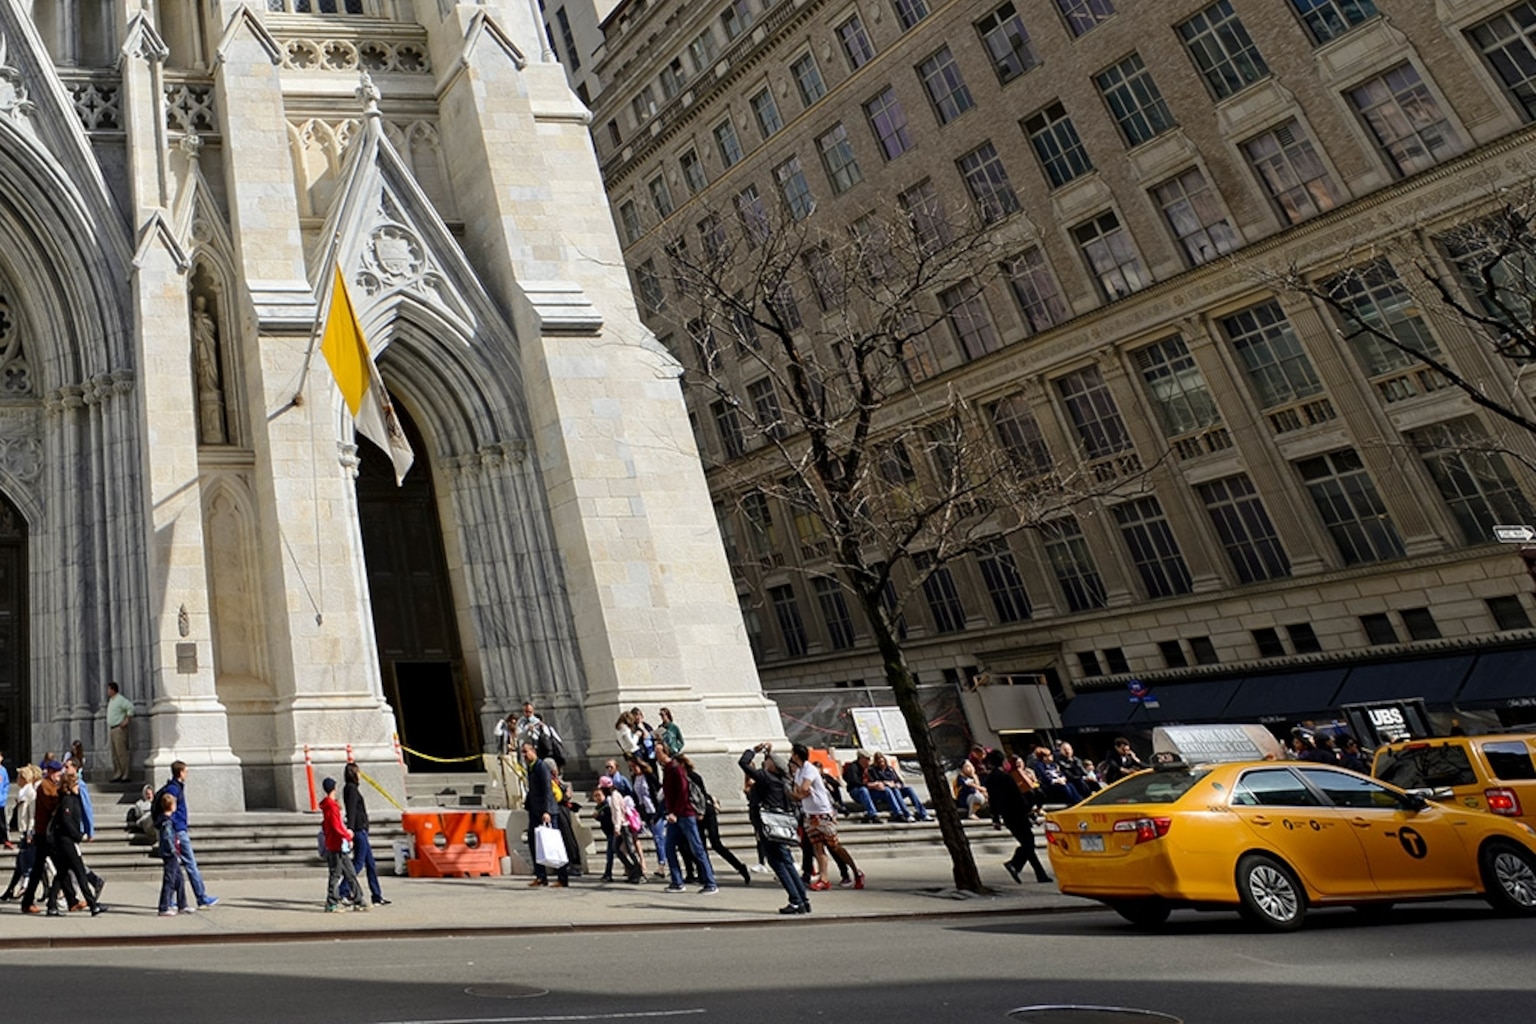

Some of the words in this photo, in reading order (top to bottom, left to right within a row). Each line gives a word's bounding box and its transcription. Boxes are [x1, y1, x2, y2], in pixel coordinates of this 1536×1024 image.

[1368, 708, 1404, 726] UBS
[1213, 728, 1249, 743] DOLLS
[1232, 741, 1257, 753] CLUB
[1402, 832, 1419, 855] T
